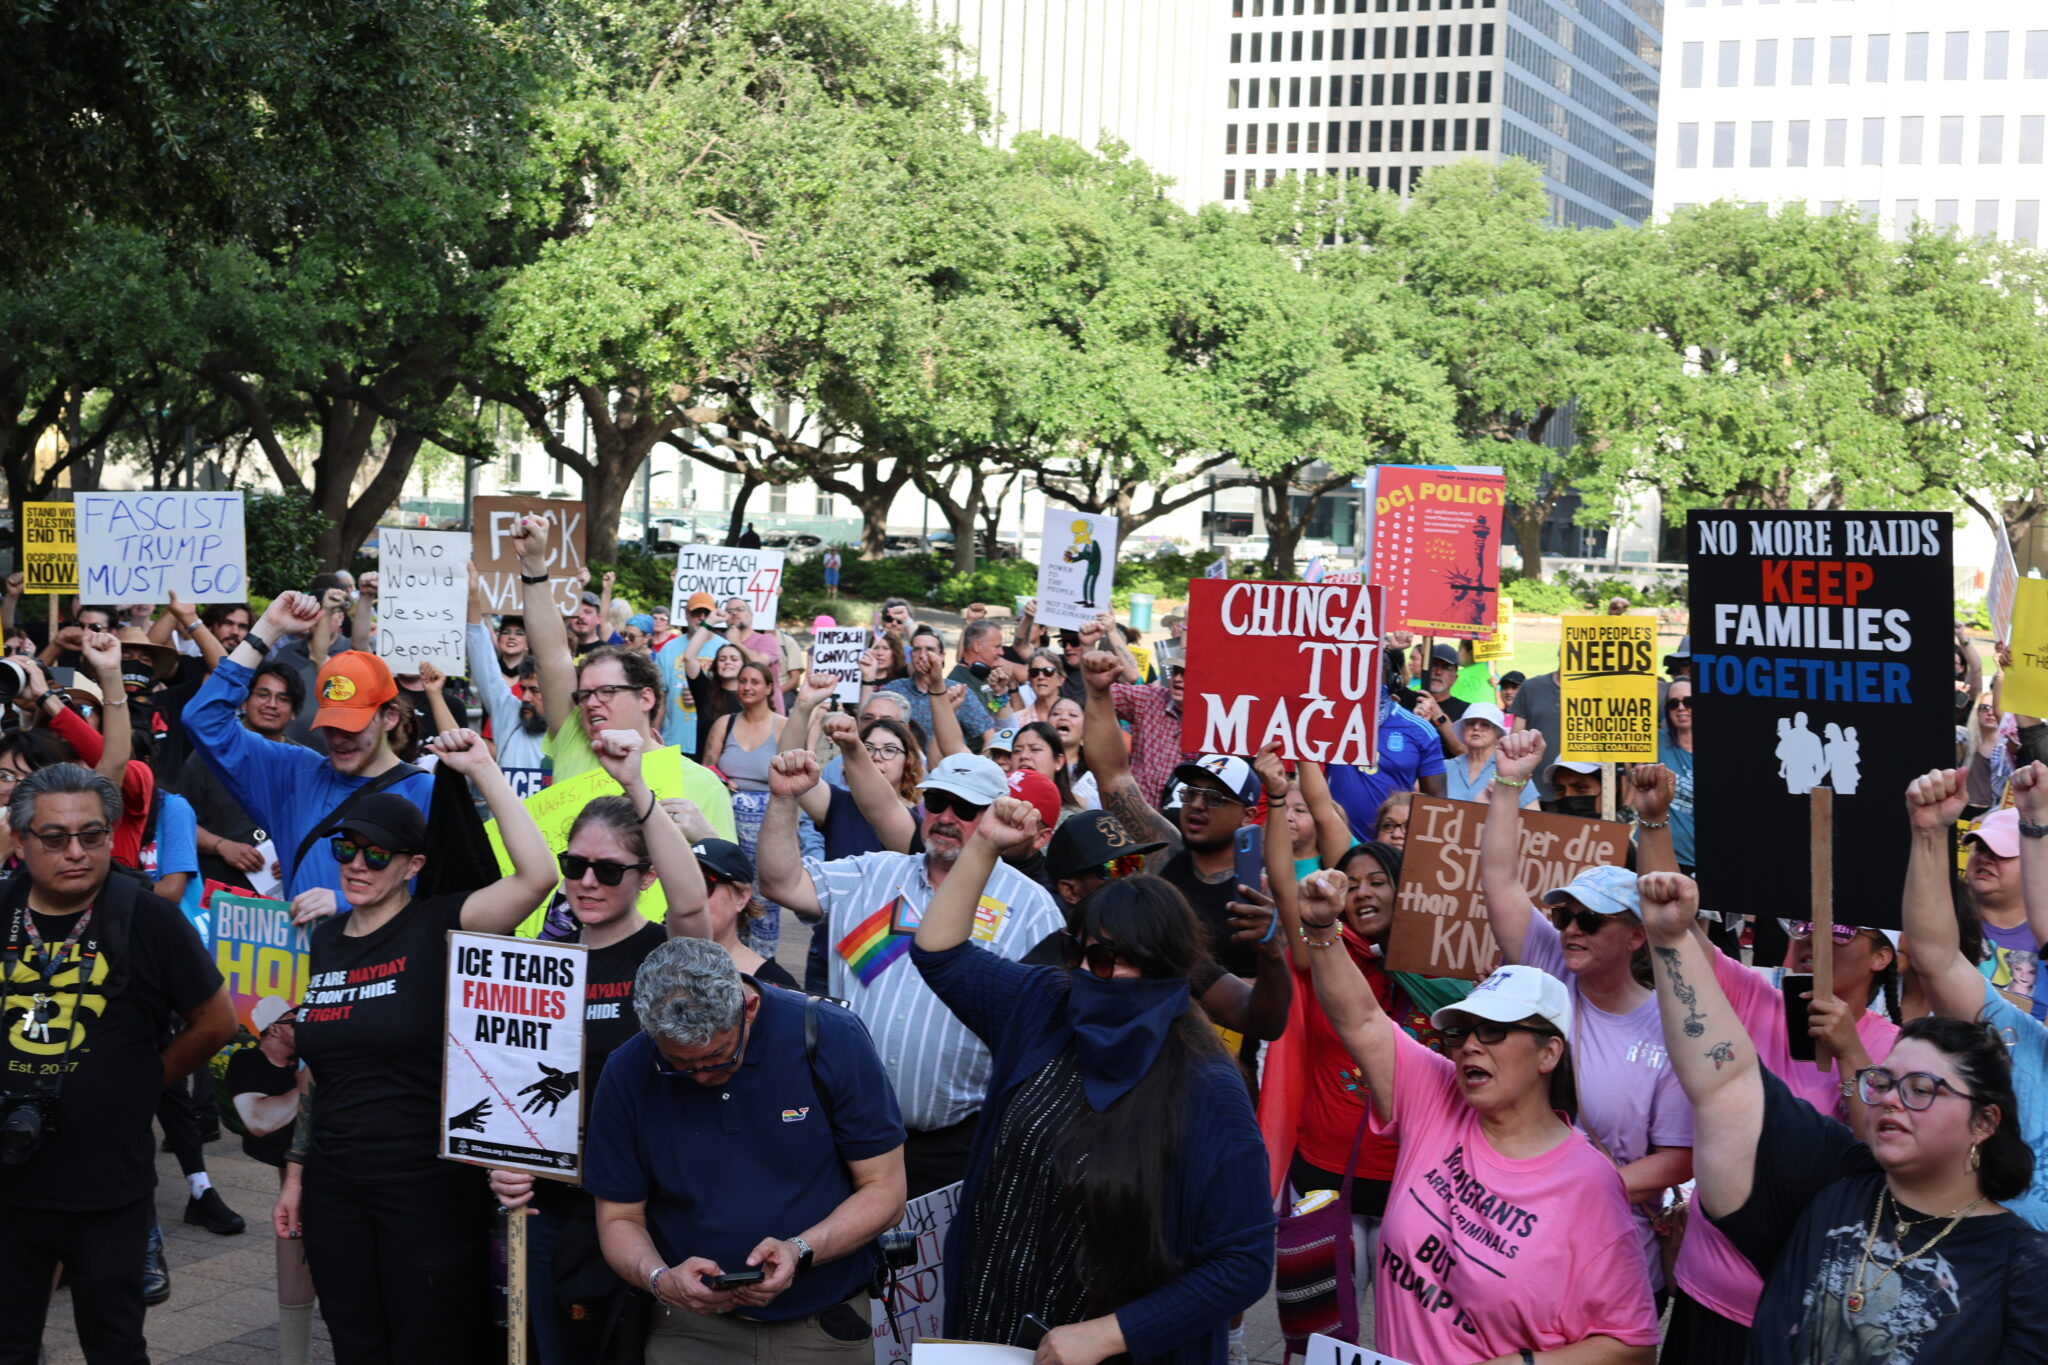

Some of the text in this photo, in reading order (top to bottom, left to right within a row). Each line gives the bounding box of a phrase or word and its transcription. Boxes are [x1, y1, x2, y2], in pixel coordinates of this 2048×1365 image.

[27, 507, 75, 517] STAND WIT
[1376, 482, 1504, 515] DCI POLICY
[27, 518, 76, 529] PALESTIN
[85, 497, 239, 533] FASCIST
[27, 529, 75, 543] END TH
[116, 535, 222, 562] TRUMP
[384, 532, 444, 558] Who
[490, 508, 581, 570] FCK
[1698, 518, 1940, 556] NO MORE RAIDS
[26, 553, 77, 562] OCCUPATIO
[28, 563, 75, 583] NOW
[682, 552, 758, 573] IMPEACH
[87, 564, 242, 596] MUST GO
[386, 564, 454, 589] Would
[677, 575, 748, 595] CONVICT
[747, 568, 780, 612] 47
[1762, 560, 1874, 606] KEEP
[383, 596, 454, 620] Jesus
[479, 571, 582, 616] NAIS
[1221, 583, 1379, 641] CHINGA
[1715, 604, 1912, 652] FAMILIES
[380, 628, 462, 662] Deport?
[818, 631, 863, 644] IMPEACH
[1566, 627, 1652, 640] FUND PEOPLE'S
[816, 649, 863, 664] CONVICT
[1299, 642, 1377, 700] TU
[1566, 641, 1652, 672] NEEDS
[1692, 654, 1912, 704] TOGETHER
[1567, 698, 1652, 718] NOT WAR
[1199, 693, 1373, 766] MAGA
[1567, 717, 1652, 732] GENOCIDE &
[1568, 732, 1651, 742] DEPORTATION
[1568, 743, 1651, 752] ANSWER COALITION
[1416, 803, 1615, 865] I'd rher die
[1436, 843, 1602, 899] STDIN
[1398, 881, 1459, 917] than
[9, 907, 23, 942] SONY
[217, 901, 290, 948] BRING
[216, 939, 311, 1005] HO
[322, 970, 348, 987] ARE
[348, 956, 407, 985] MAYDAY
[457, 946, 575, 988] ICE TEARS
[315, 988, 358, 1005] DON'T
[359, 979, 397, 1000] HIDE
[462, 979, 567, 1020] FAMILIES
[307, 1005, 353, 1022] FIGHT
[586, 1003, 621, 1020] HIDE
[474, 1014, 553, 1051] APART
[8, 1060, 35, 1074] Est.
[1450, 1204, 1520, 1260] CRIMINALS
[1415, 1234, 1457, 1284] BUT
[1381, 1243, 1454, 1314] TRUMP
